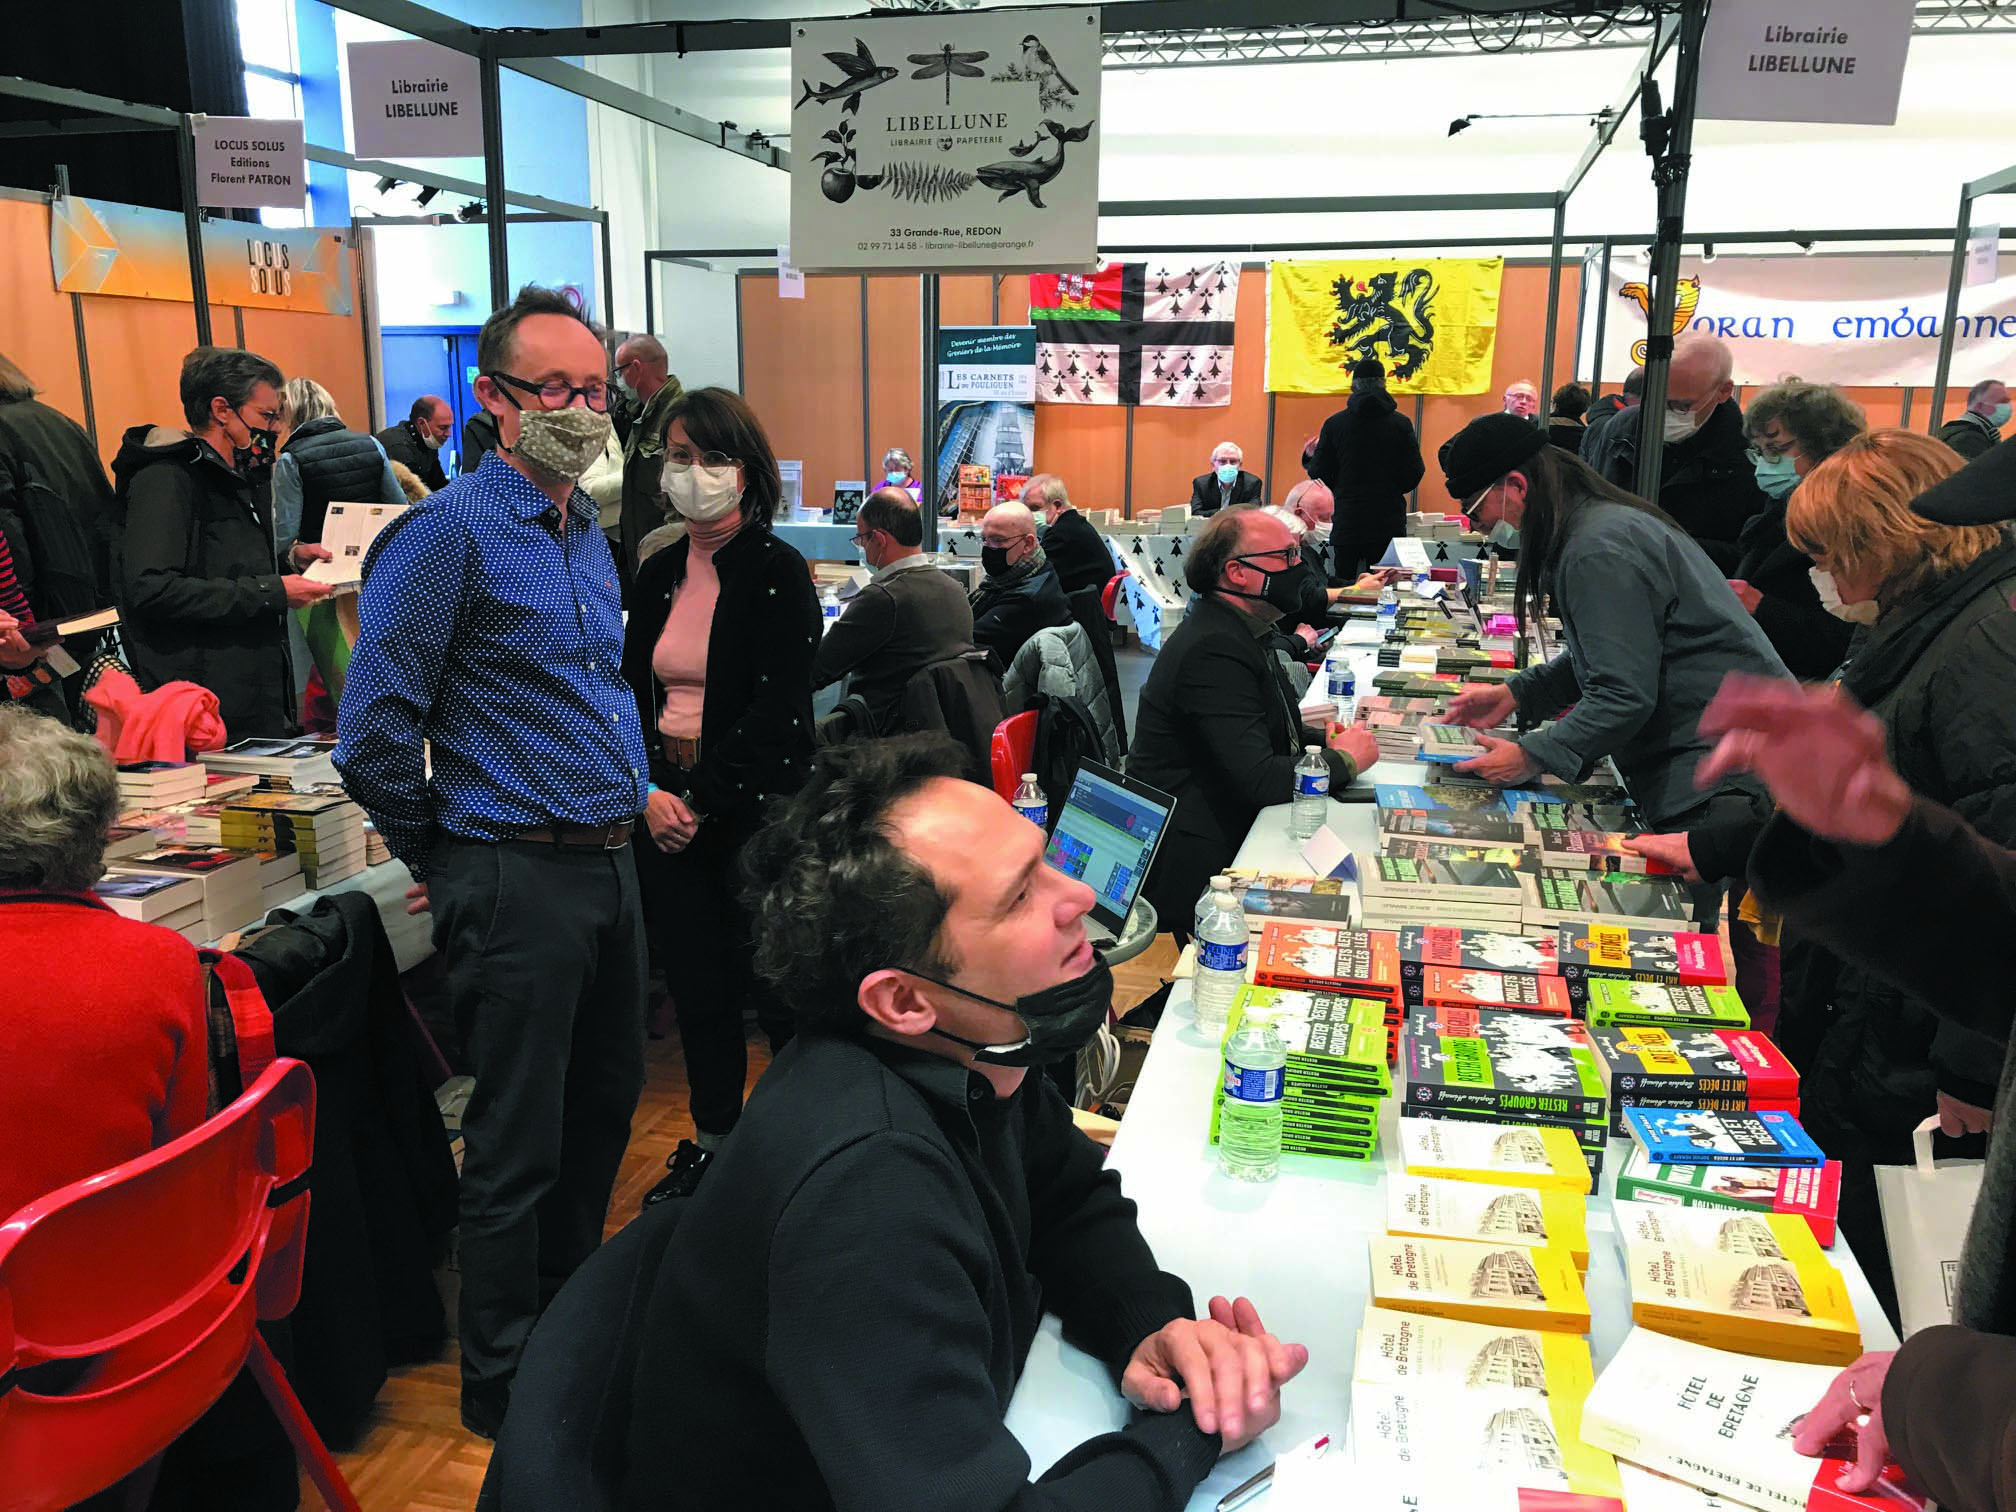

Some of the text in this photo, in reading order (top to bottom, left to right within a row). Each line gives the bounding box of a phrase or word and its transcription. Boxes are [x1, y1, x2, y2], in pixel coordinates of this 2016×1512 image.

[1764, 26, 1848, 45] Librairie
[1748, 55, 1856, 75] LIBELLUNE
[391, 79, 449, 96] Librairie
[385, 101, 458, 119] LIBELLUNE
[886, 113, 1008, 132] LIBELLUNE
[214, 140, 285, 152] LOCUS SOLUS
[890, 136, 1003, 147] LIBRAIRIE PAPETERIE
[231, 157, 270, 169] Editions
[211, 173, 291, 186] Florent PATRON
[890, 227, 1001, 238] 33 Grande-Rue, REDON
[247, 239, 289, 268] LOCUS
[857, 242, 868, 250] 02
[870, 242, 880, 250] 99
[882, 242, 891, 250] 71
[893, 241, 904, 250] 14
[906, 241, 917, 249] 58
[250, 266, 292, 297] SOLUS
[1503, 975, 1520, 1002] POULETS
[1518, 975, 1539, 1003] GRILLÉS
[1699, 1079, 1720, 1093] DÉCÈS
[1721, 1080, 1730, 1091] ET
[1732, 1080, 1746, 1091] ART
[1500, 1094, 1536, 1112] GROUPÉS
[1539, 1097, 1568, 1112] RESTER
[1721, 1100, 1730, 1111] ET
[1733, 1100, 1746, 1111] ART
[1721, 1117, 1757, 1146] ART ET
[1389, 1254, 1402, 1275] Hôtel
[1404, 1243, 1419, 1291] de Bretagne
[1648, 1261, 1661, 1283] Hôtel
[1662, 1250, 1677, 1298] de Bretagne
[1382, 1333, 1396, 1358] Hôtel
[1395, 1321, 1410, 1376] de Bretagne
[1706, 1391, 1726, 1410] DE
[1718, 1373, 1760, 1439] BRETAGNE
